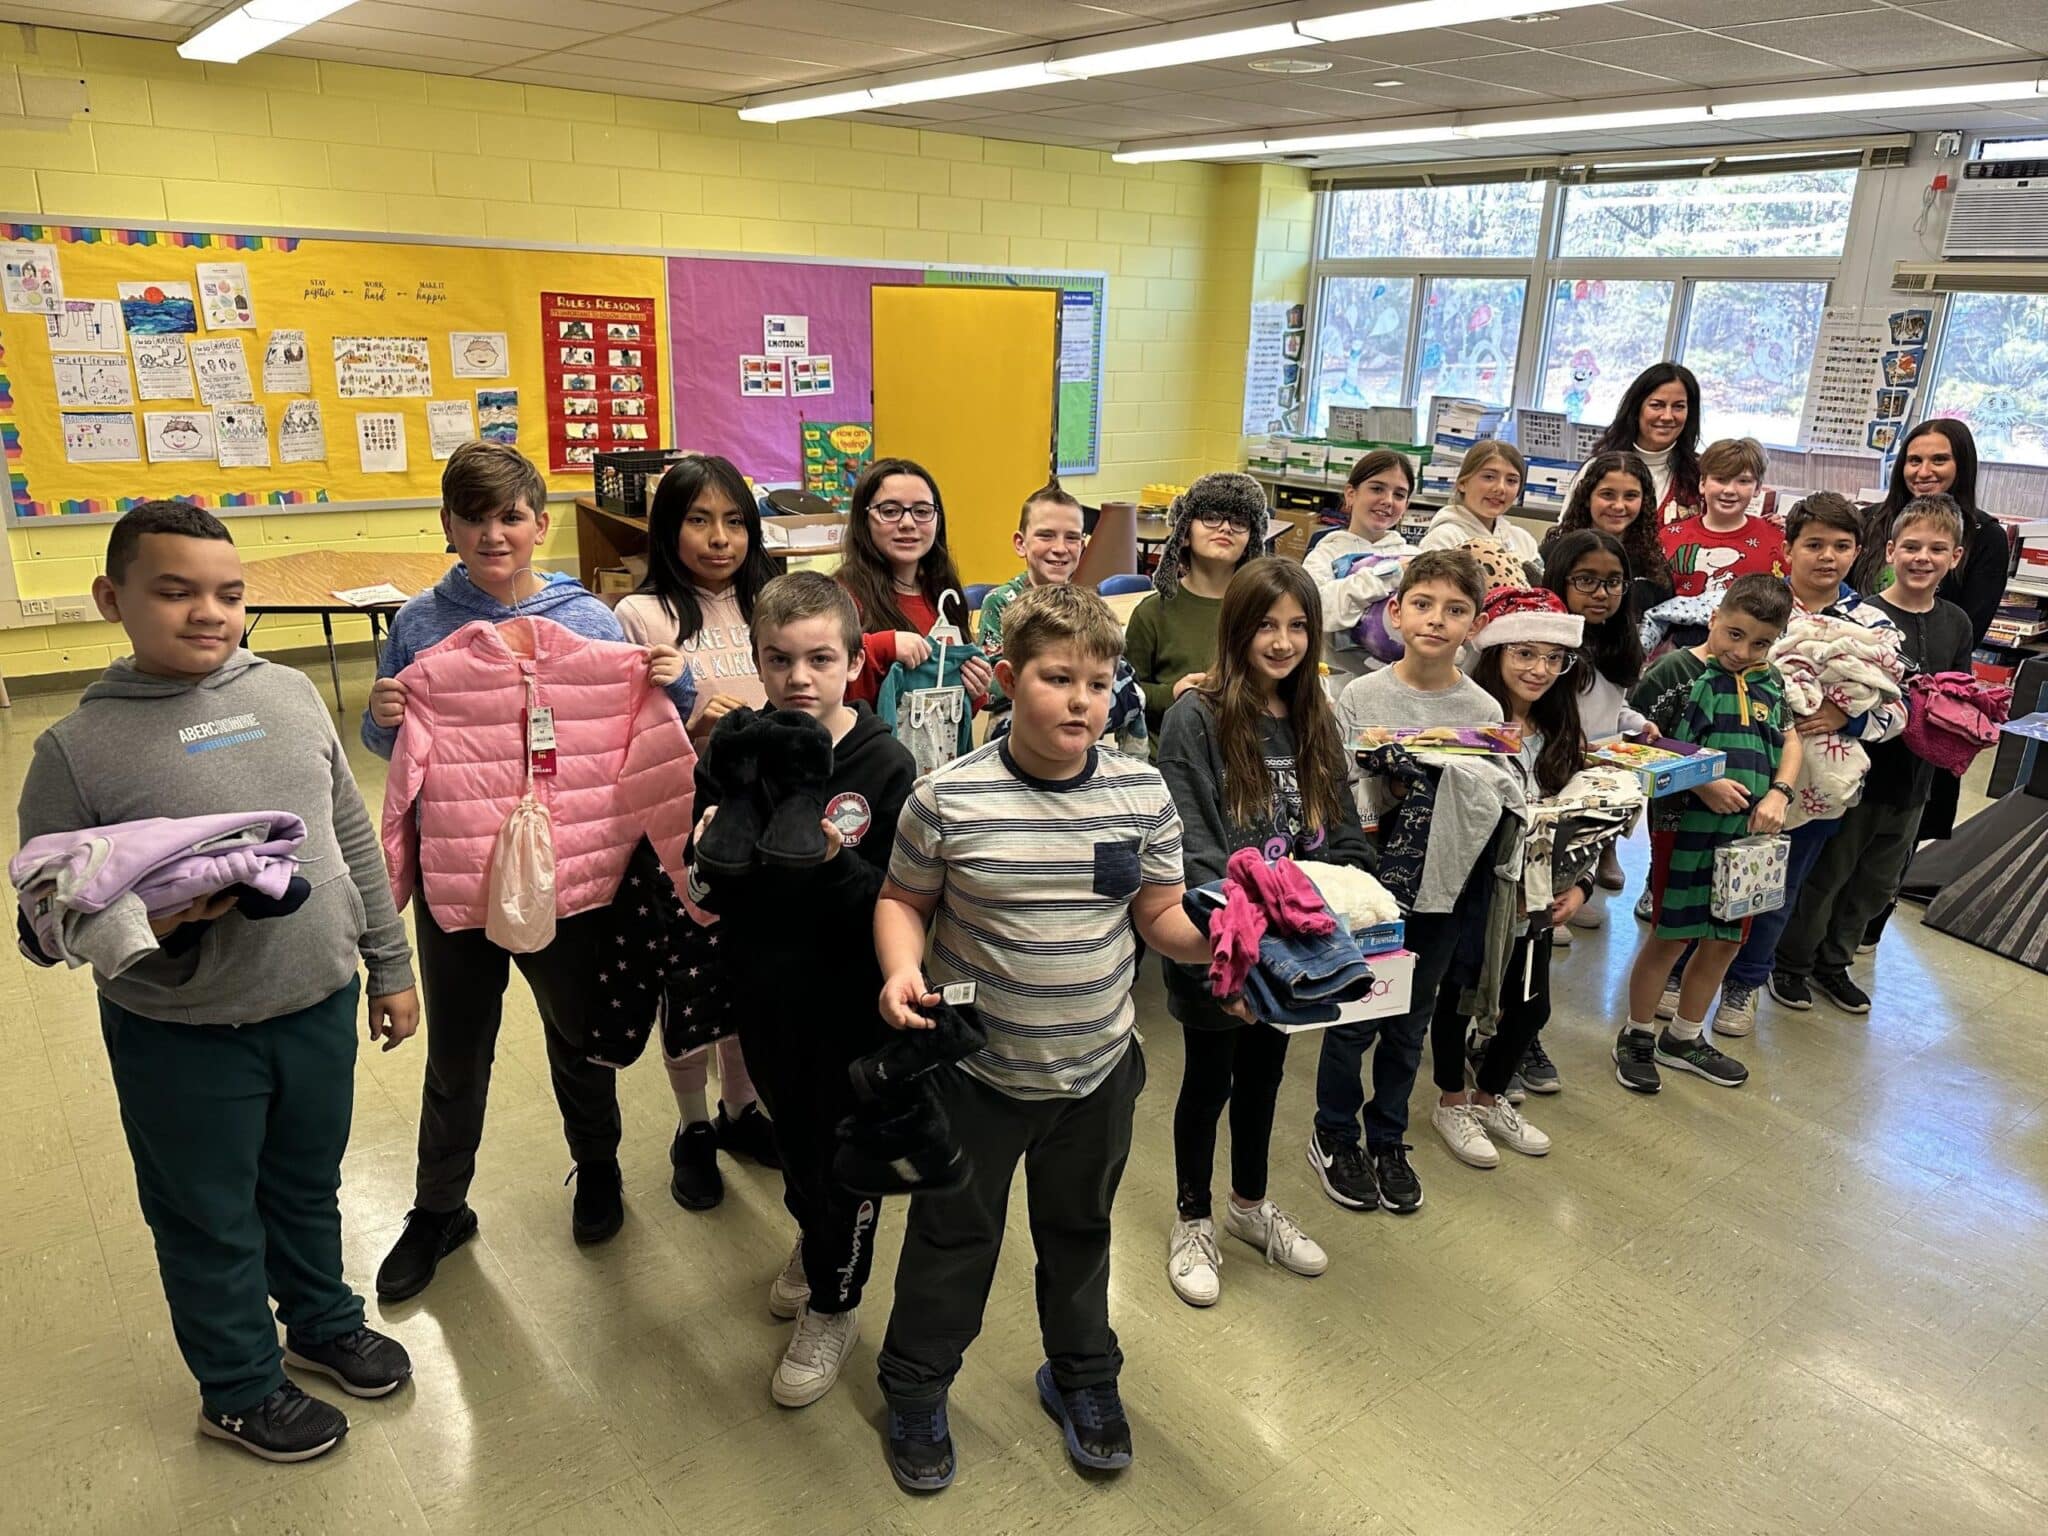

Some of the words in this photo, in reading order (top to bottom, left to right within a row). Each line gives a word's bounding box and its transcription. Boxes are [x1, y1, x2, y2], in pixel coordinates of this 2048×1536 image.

[310, 279, 327, 287] STAY
[364, 281, 384, 289] WORK
[304, 287, 336, 300] positive
[364, 288, 387, 301] hard
[416, 288, 447, 304] happen
[557, 296, 591, 309] RULES
[595, 298, 640, 311] REASONS
[768, 340, 805, 348] EMOTIONS
[691, 655, 707, 680] A
[711, 650, 758, 677] KIN
